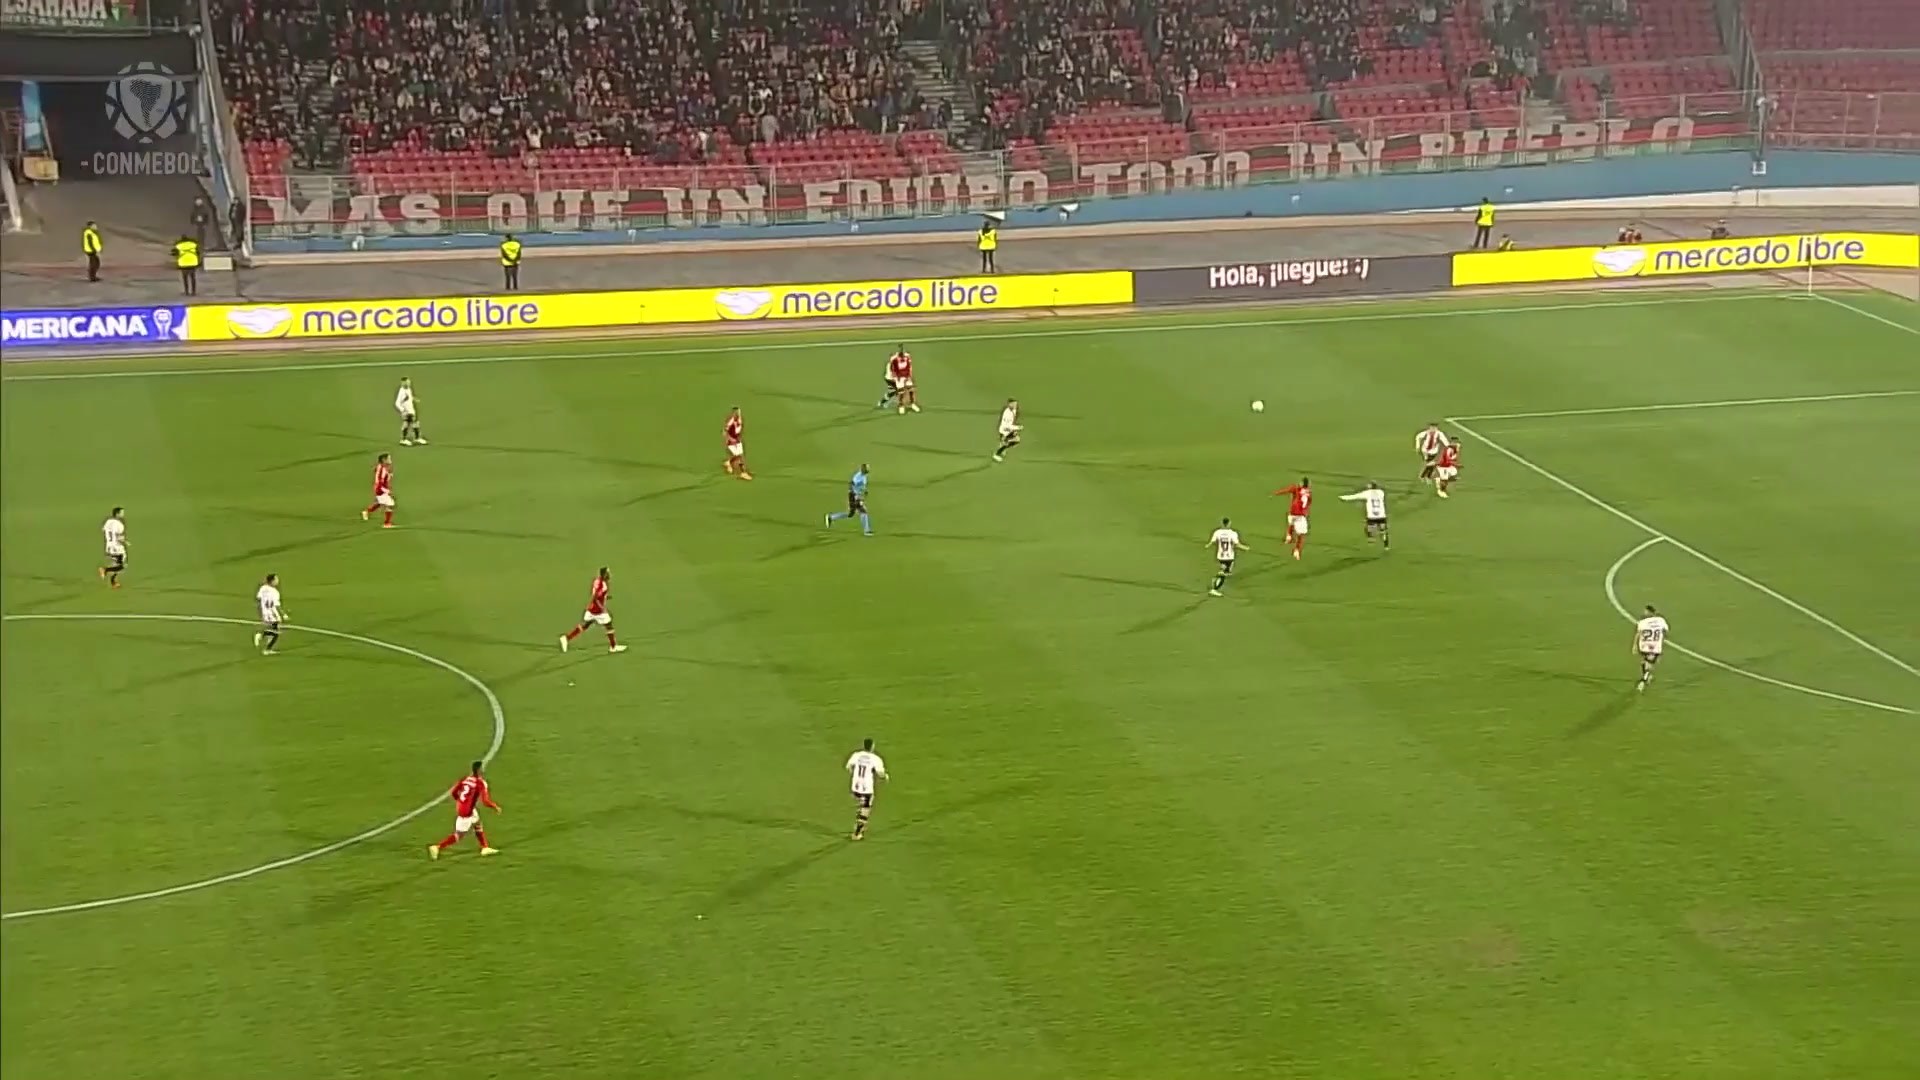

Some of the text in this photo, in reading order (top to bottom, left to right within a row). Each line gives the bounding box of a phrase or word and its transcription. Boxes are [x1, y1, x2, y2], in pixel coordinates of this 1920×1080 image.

[268, 194, 440, 236] MAS
[487, 189, 630, 231] QUE
[662, 184, 767, 227] UN
[1655, 237, 1865, 271] mercado libre
[1209, 263, 1265, 289] Hola,
[782, 281, 998, 314] mercado libre
[1, 315, 148, 341] MERICANA
[303, 299, 539, 332] mercado libre
